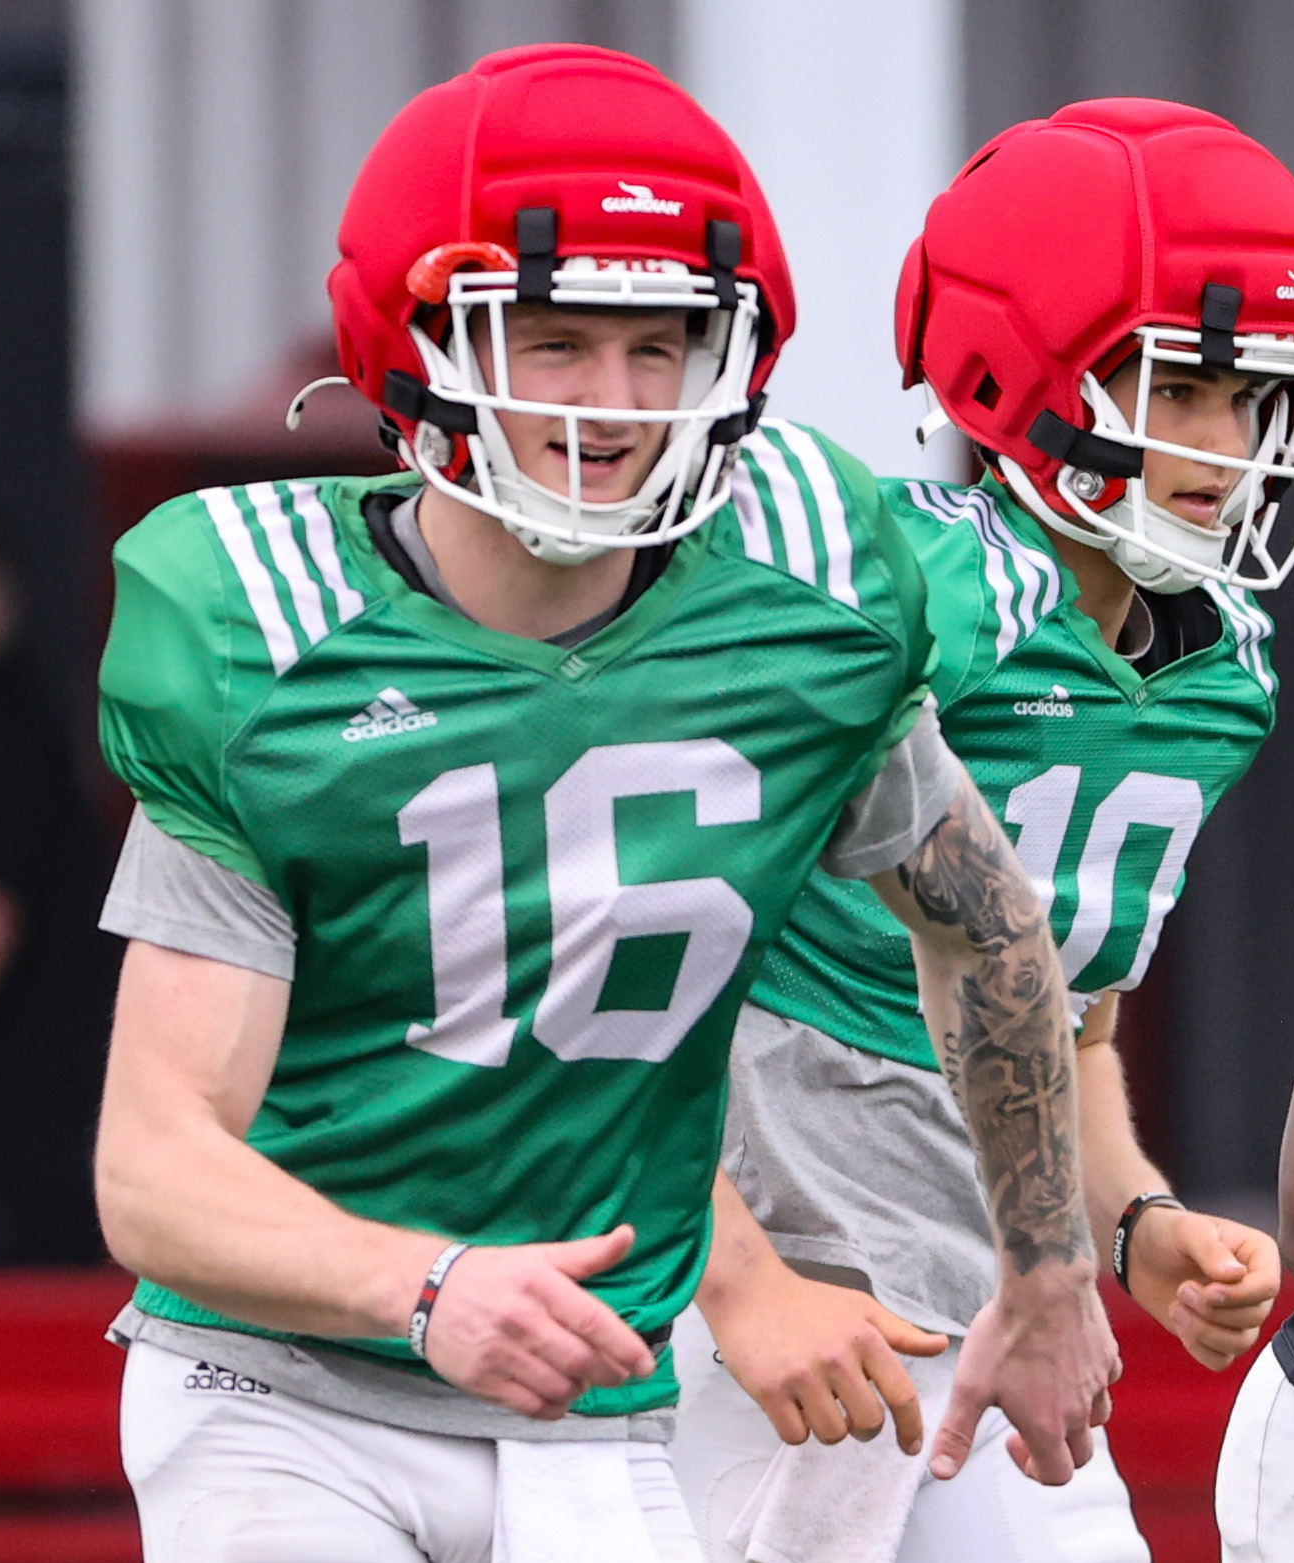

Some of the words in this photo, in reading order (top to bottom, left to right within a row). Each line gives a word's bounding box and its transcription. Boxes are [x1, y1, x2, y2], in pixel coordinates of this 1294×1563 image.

[601, 196, 681, 217] GUARDIAN
[1013, 699, 1074, 718] adidas
[341, 712, 438, 742] adidas
[1005, 764, 1203, 991] 10
[397, 737, 762, 1068] 16
[1113, 1227, 1125, 1274] CHOP
[184, 1371, 271, 1394] adidas
